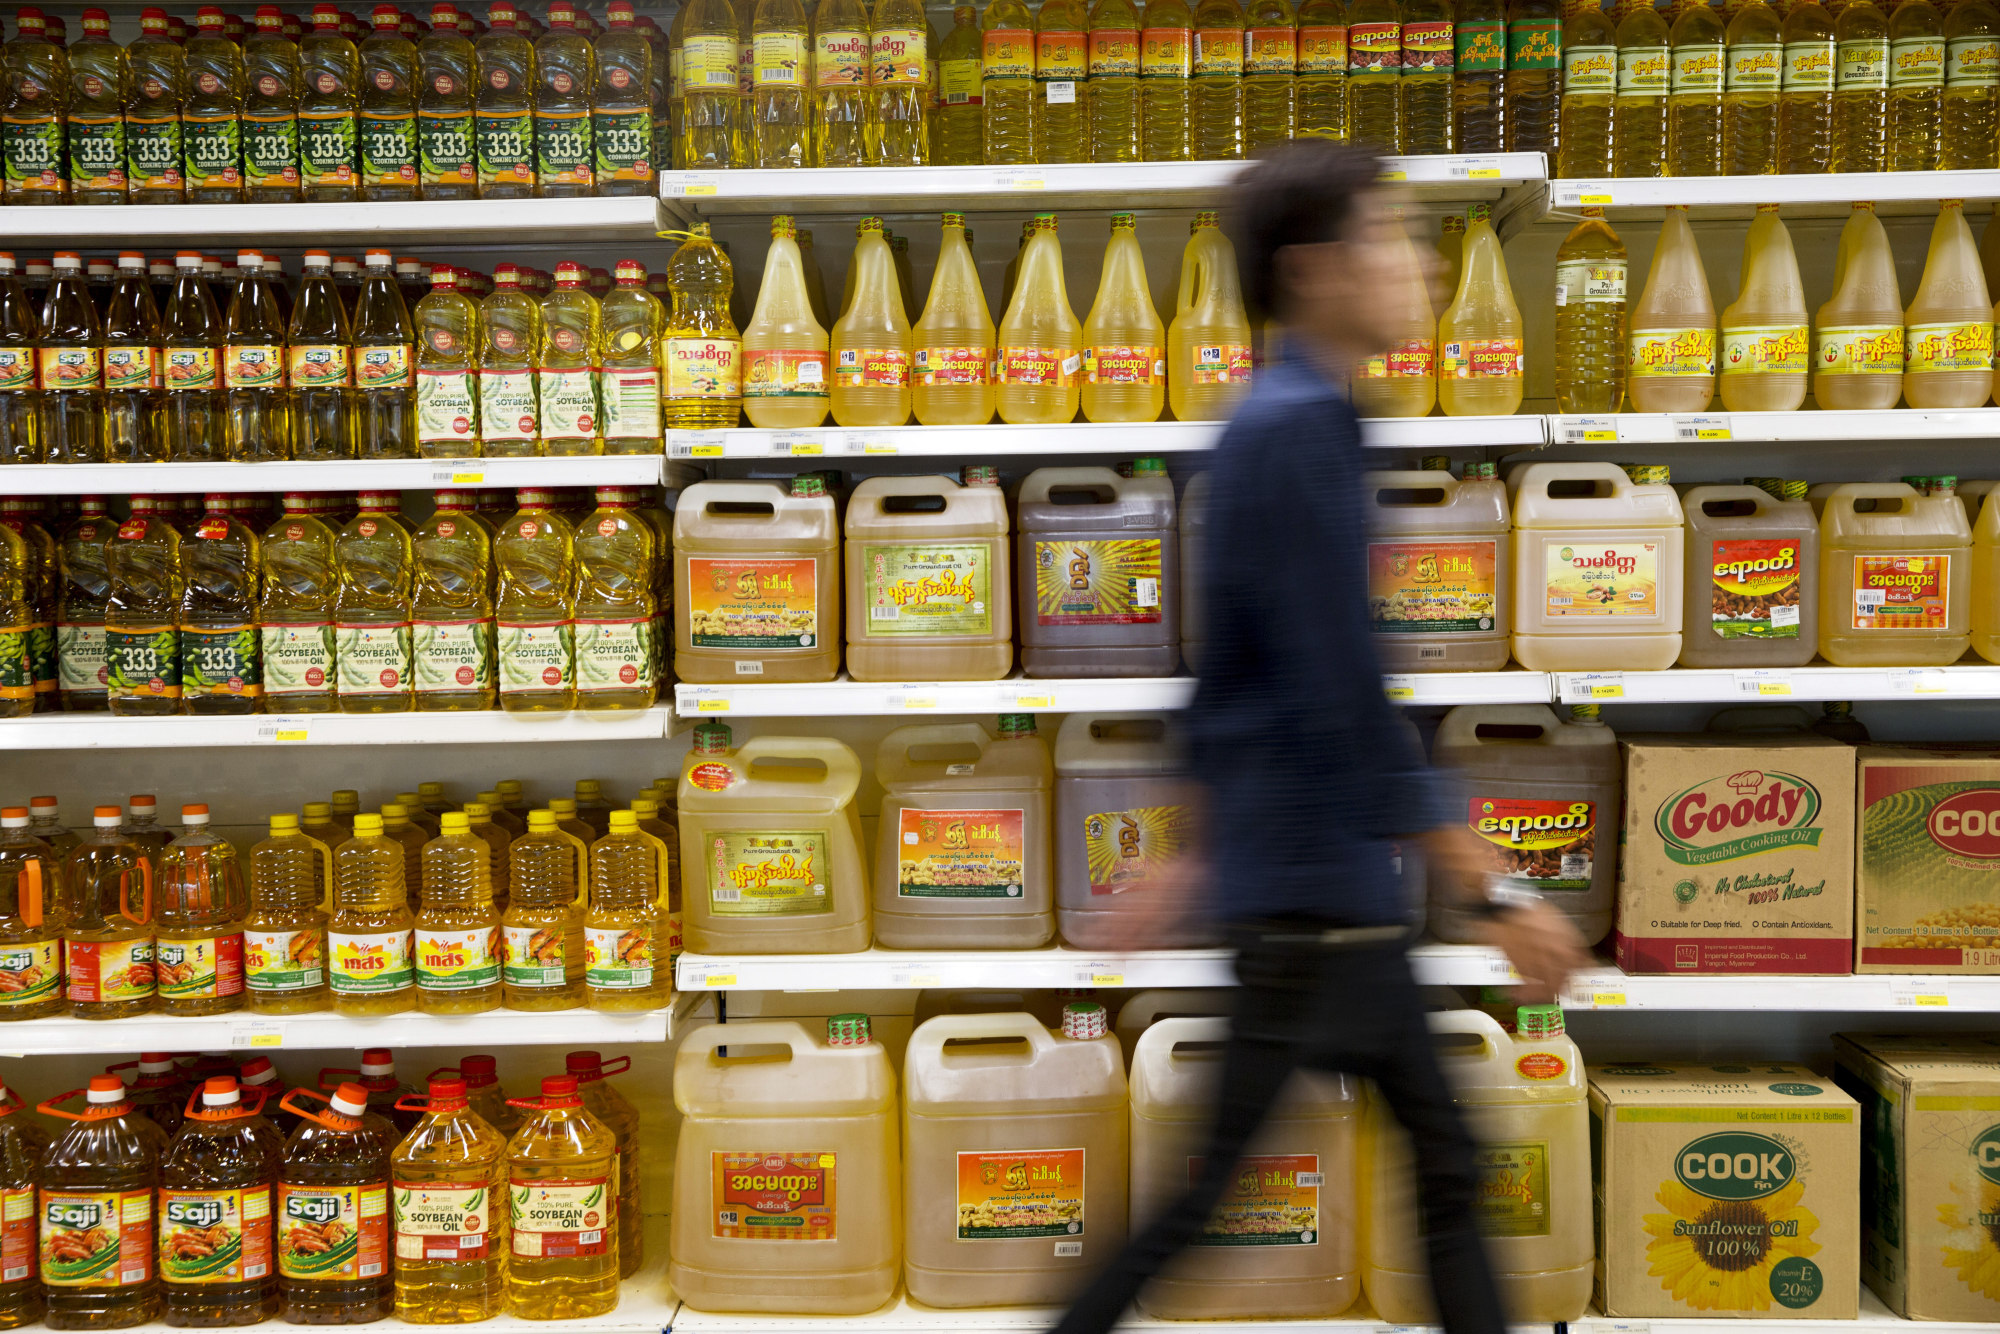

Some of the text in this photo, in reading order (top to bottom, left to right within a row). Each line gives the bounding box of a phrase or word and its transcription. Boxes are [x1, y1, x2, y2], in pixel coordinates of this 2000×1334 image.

[196, 136, 229, 159] 333
[255, 136, 288, 159] 333
[311, 134, 344, 157] 333
[372, 134, 406, 157] 333
[432, 133, 466, 156] 333
[488, 132, 521, 155] 333
[548, 133, 582, 156] 333
[607, 130, 641, 153] 333
[15, 139, 48, 161] 333
[82, 139, 114, 161] 333
[138, 139, 171, 161] 333
[59, 352, 85, 365] Saji
[108, 352, 130, 365] Saji
[172, 353, 194, 366] Saji
[241, 352, 264, 364] Saji
[495, 398, 535, 407] SOYBEAN
[556, 397, 594, 406] SOYBEAN
[278, 648, 324, 657] SOYBEAN
[353, 649, 399, 658] SOYBEAN
[428, 647, 475, 656] SOYBEAN
[515, 649, 562, 658] SOYBEAN
[592, 646, 638, 654] SOYBEAN
[123, 647, 157, 671] 333
[201, 647, 236, 671] 333
[310, 656, 324, 665] OIL
[384, 657, 399, 665] OIL
[460, 656, 475, 664] OIL
[547, 657, 561, 666] OIL
[624, 654, 638, 662] OIL
[1672, 782, 1807, 839] Goody
[1686, 829, 1811, 864] Vegetable Cooking Oil
[1947, 857, 1964, 867] 100%
[1965, 861, 1990, 870] Refined
[1715, 868, 1794, 894] No Cholesterol
[1748, 880, 1825, 905] 100% Natural
[1703, 921, 1721, 929] Deep
[1866, 926, 1879, 934] Net
[1882, 926, 1912, 935] Content
[1931, 927, 1952, 935] Litres
[1973, 927, 1998, 935] Bottles
[1965, 952, 1979, 965] 1.9
[1736, 1112, 1748, 1120] Net
[1823, 1112, 1846, 1120] Bottles
[1682, 1153, 1786, 1180] COOK
[50, 1205, 97, 1228] Saji
[170, 1203, 217, 1226] Saji
[288, 1199, 336, 1223] Saji
[411, 1213, 463, 1222] SOYBEAN
[530, 1210, 582, 1218] SOYBEAN
[443, 1223, 460, 1231] OIL
[562, 1219, 580, 1228] OIL
[1674, 1220, 1798, 1236] Sunflower Oil
[1801, 1266, 1813, 1280] E
